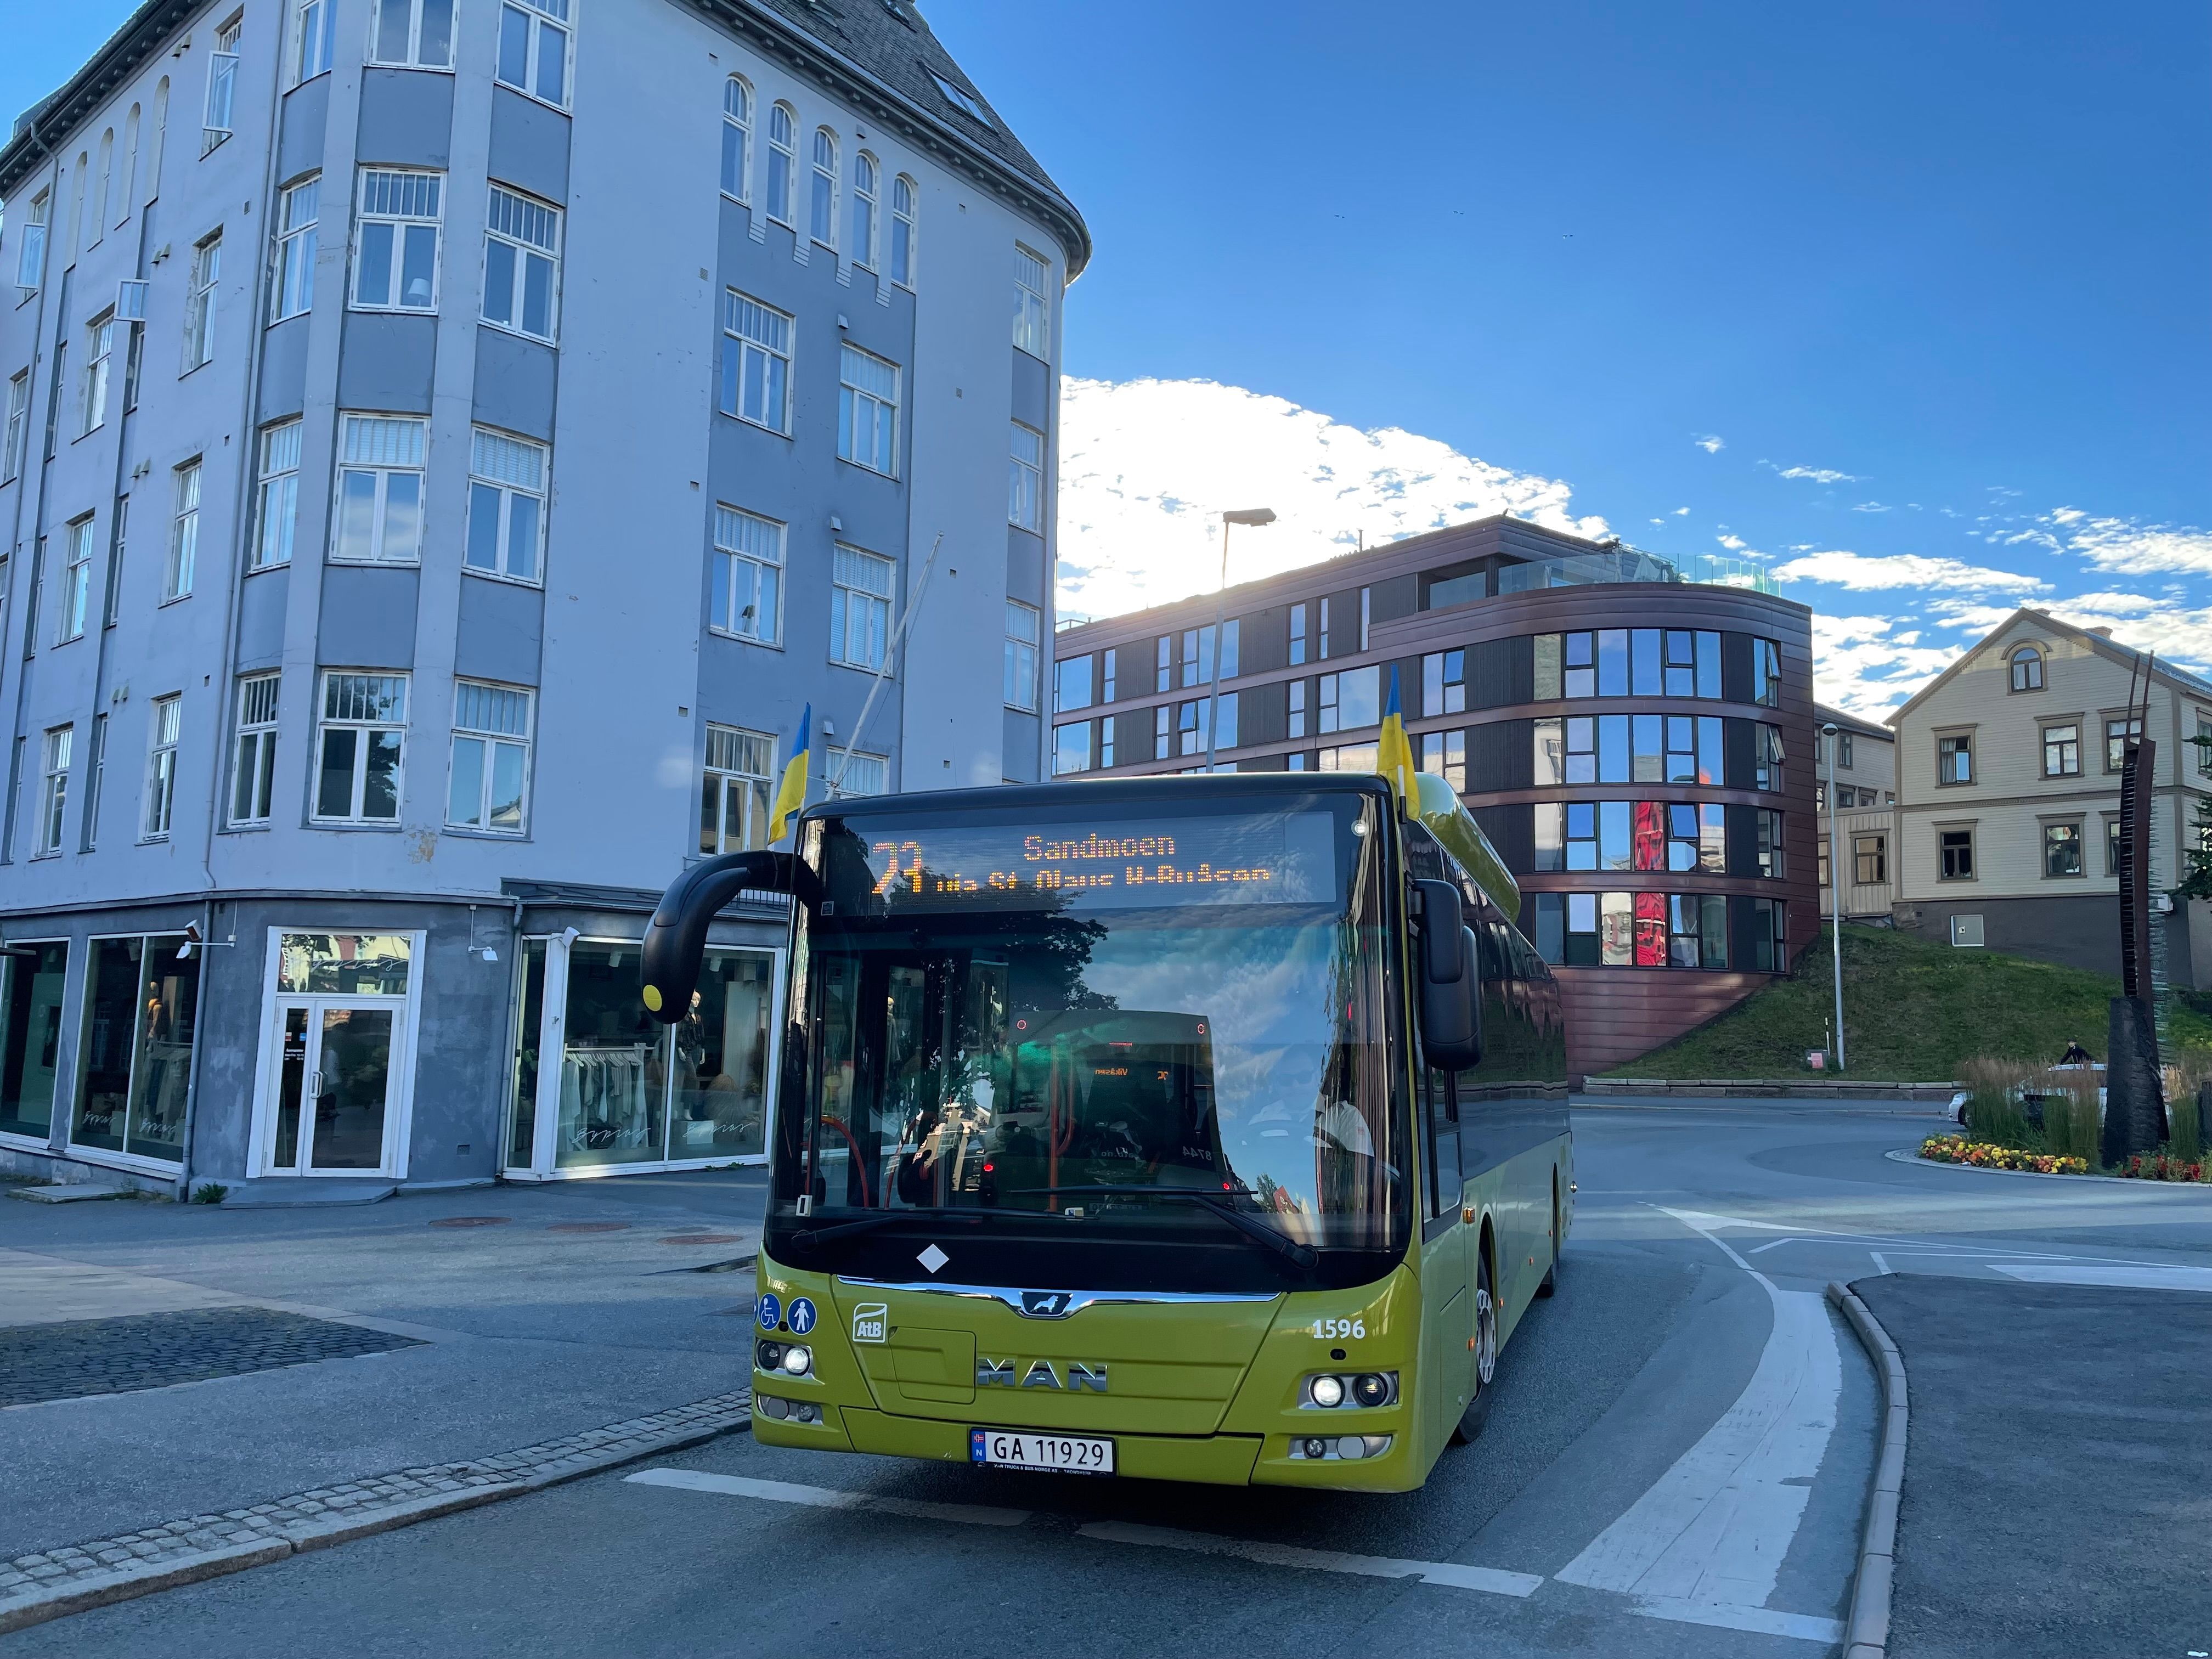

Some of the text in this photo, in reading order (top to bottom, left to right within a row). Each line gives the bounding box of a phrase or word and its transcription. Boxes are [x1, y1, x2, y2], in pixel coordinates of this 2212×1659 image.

[1024, 833, 1175, 861] Sandmoen
[571, 1127, 651, 1144] Bypias
[856, 1321, 882, 1338] AtB
[1312, 1319, 1366, 1339] 1596
[978, 1357, 1108, 1392] MAN
[994, 1437, 1103, 1466] GA 11929
